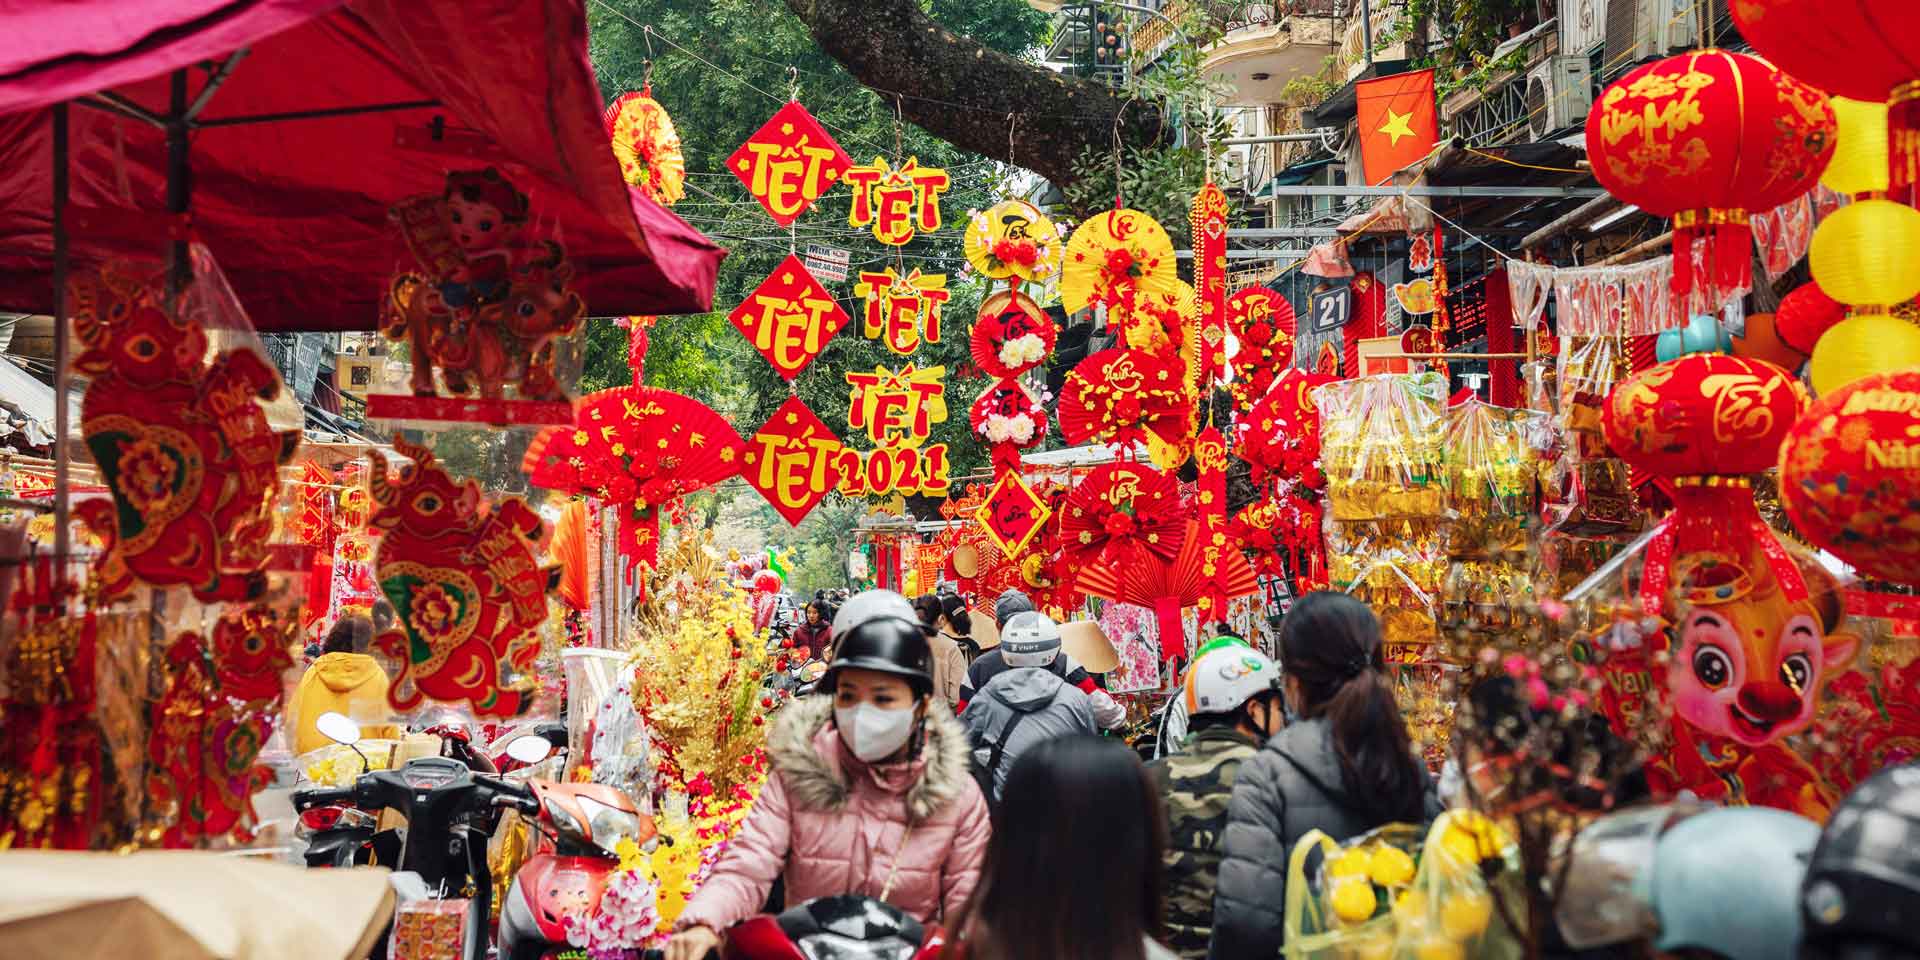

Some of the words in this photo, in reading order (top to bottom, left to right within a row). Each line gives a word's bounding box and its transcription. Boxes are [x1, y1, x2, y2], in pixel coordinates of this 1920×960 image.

[748, 134, 835, 216] TẾT
[843, 156, 949, 245] TẾT
[755, 286, 834, 369] TẾT
[854, 267, 950, 354] TẾT
[1319, 292, 1346, 327] 21
[623, 398, 667, 420] Xuân
[846, 362, 948, 450] TẾT
[1700, 375, 1782, 443] Tết
[756, 425, 841, 508] TẾT
[838, 444, 951, 497] 2021
